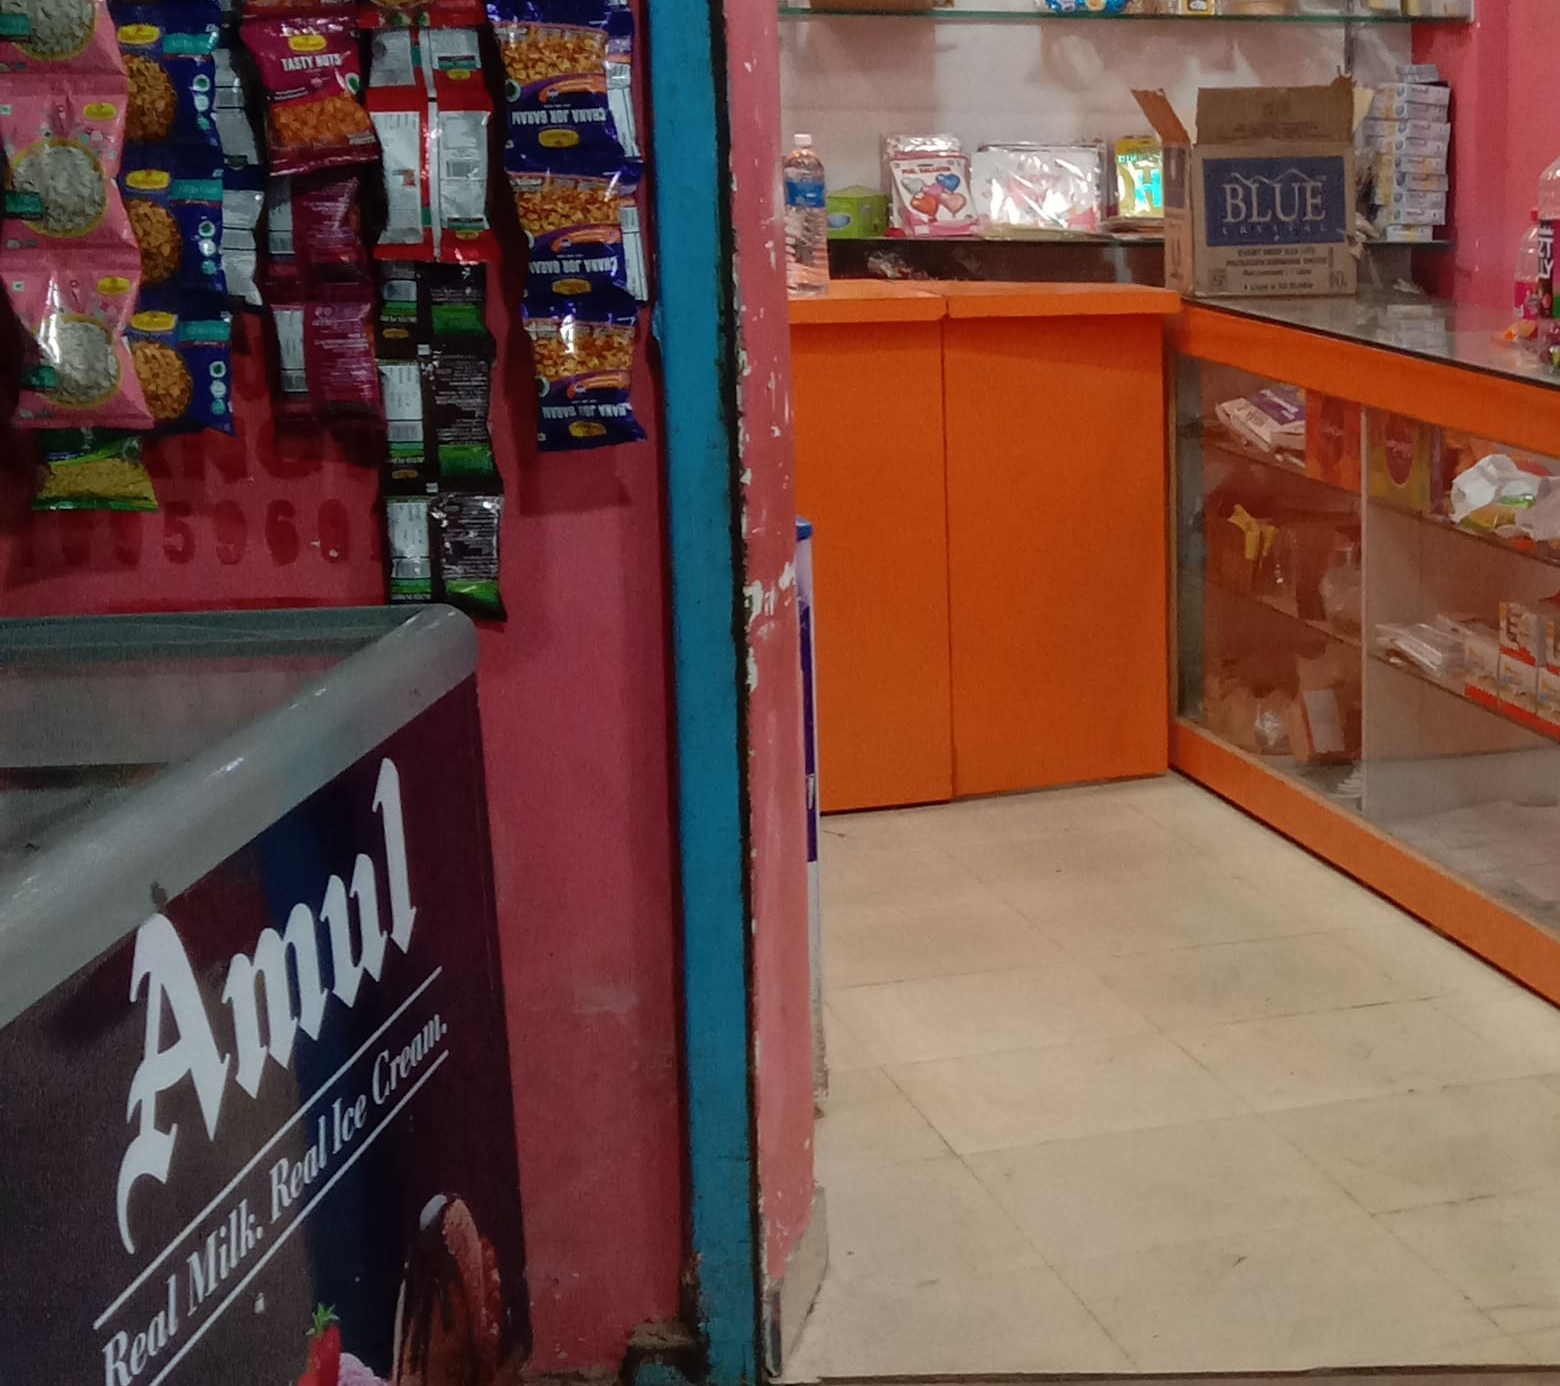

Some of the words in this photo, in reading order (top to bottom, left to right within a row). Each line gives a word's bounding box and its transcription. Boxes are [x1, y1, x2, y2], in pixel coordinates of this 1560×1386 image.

[280, 54, 313, 71] TASTY
[315, 52, 342, 68] NUTS
[1223, 181, 1327, 223] BLUE
[116, 757, 417, 1255] Amul
[186, 1209, 264, 1319] Milk.
[269, 1113, 329, 1223] Real
[332, 1093, 369, 1158] Ice
[372, 1013, 449, 1108] Cream.
